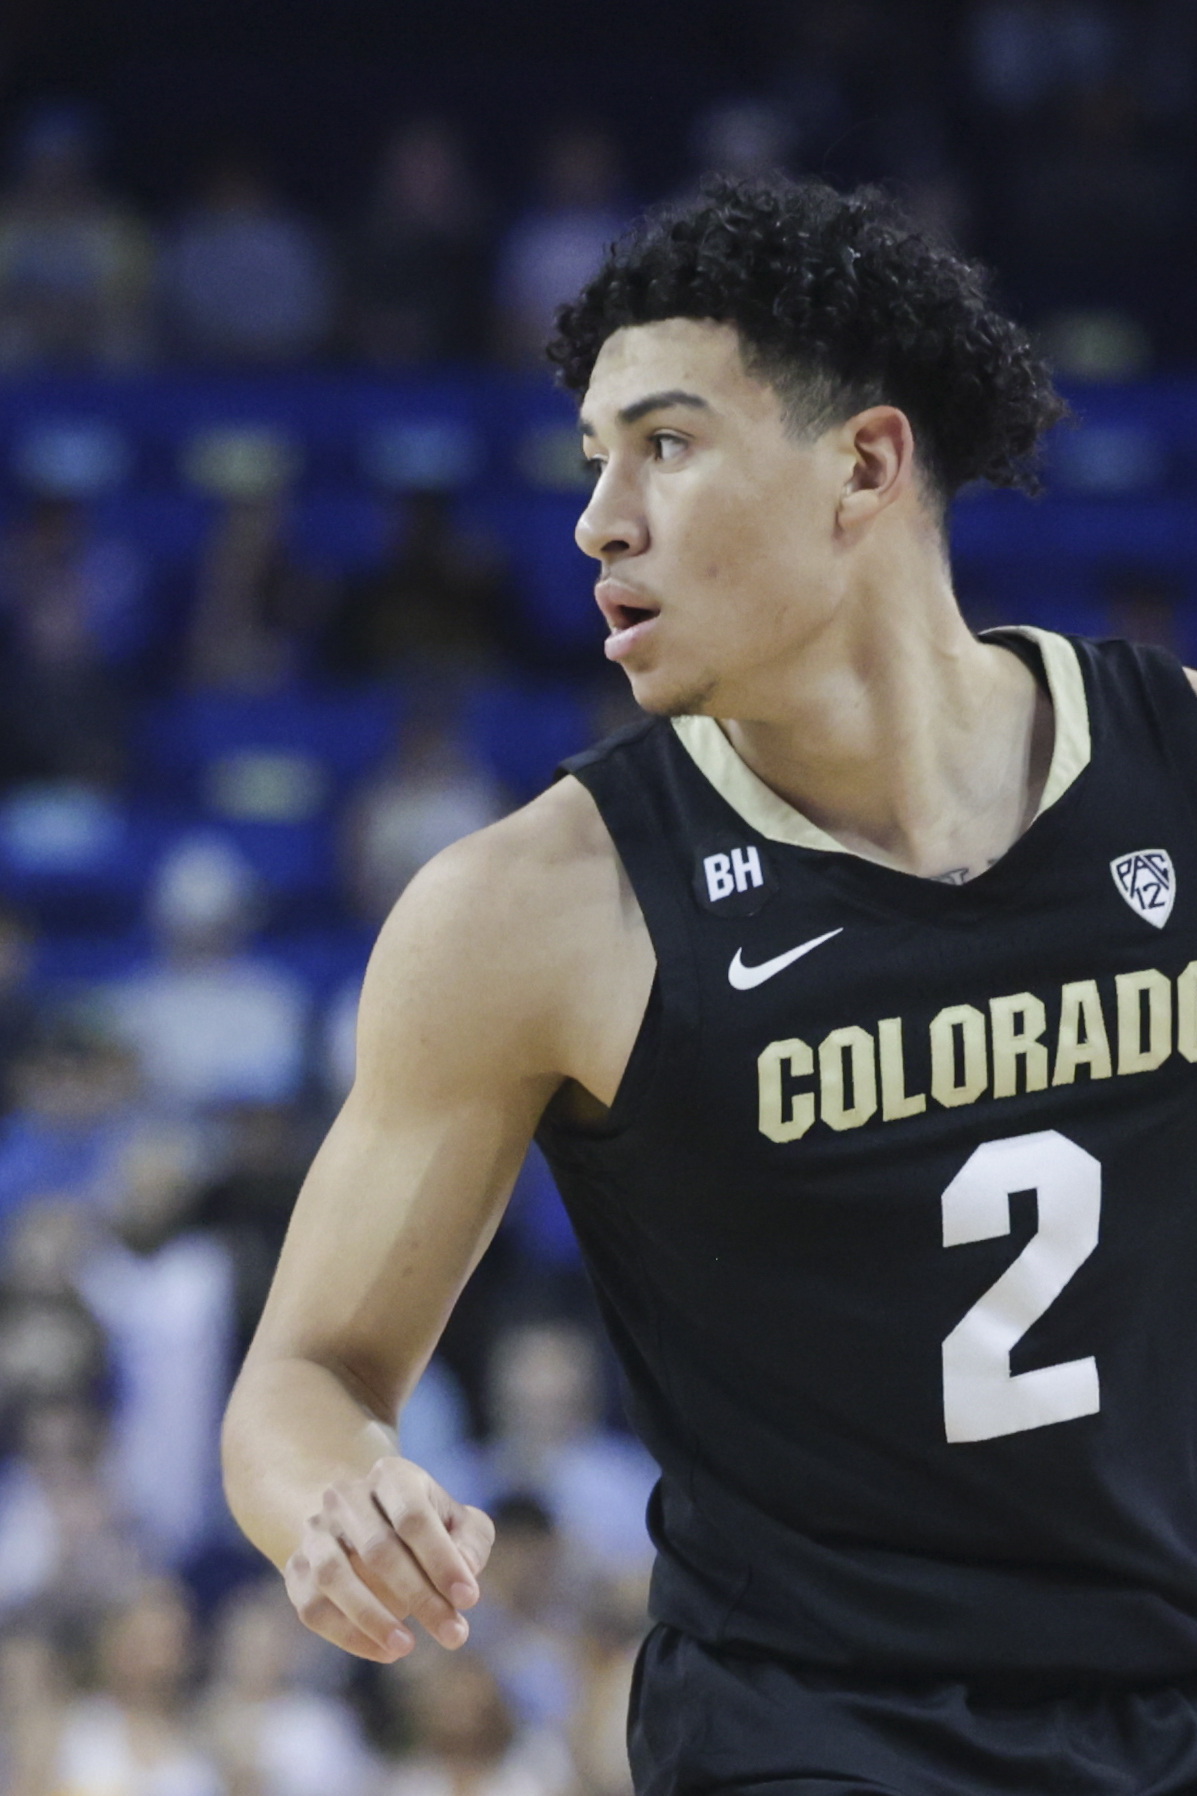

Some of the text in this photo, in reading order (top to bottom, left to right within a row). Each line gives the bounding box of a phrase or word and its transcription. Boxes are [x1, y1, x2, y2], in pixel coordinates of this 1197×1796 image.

[703, 845, 764, 902] BH
[1116, 854, 1169, 899] PAC
[1134, 882, 1166, 910] 12
[941, 1129, 1101, 1443] 2
